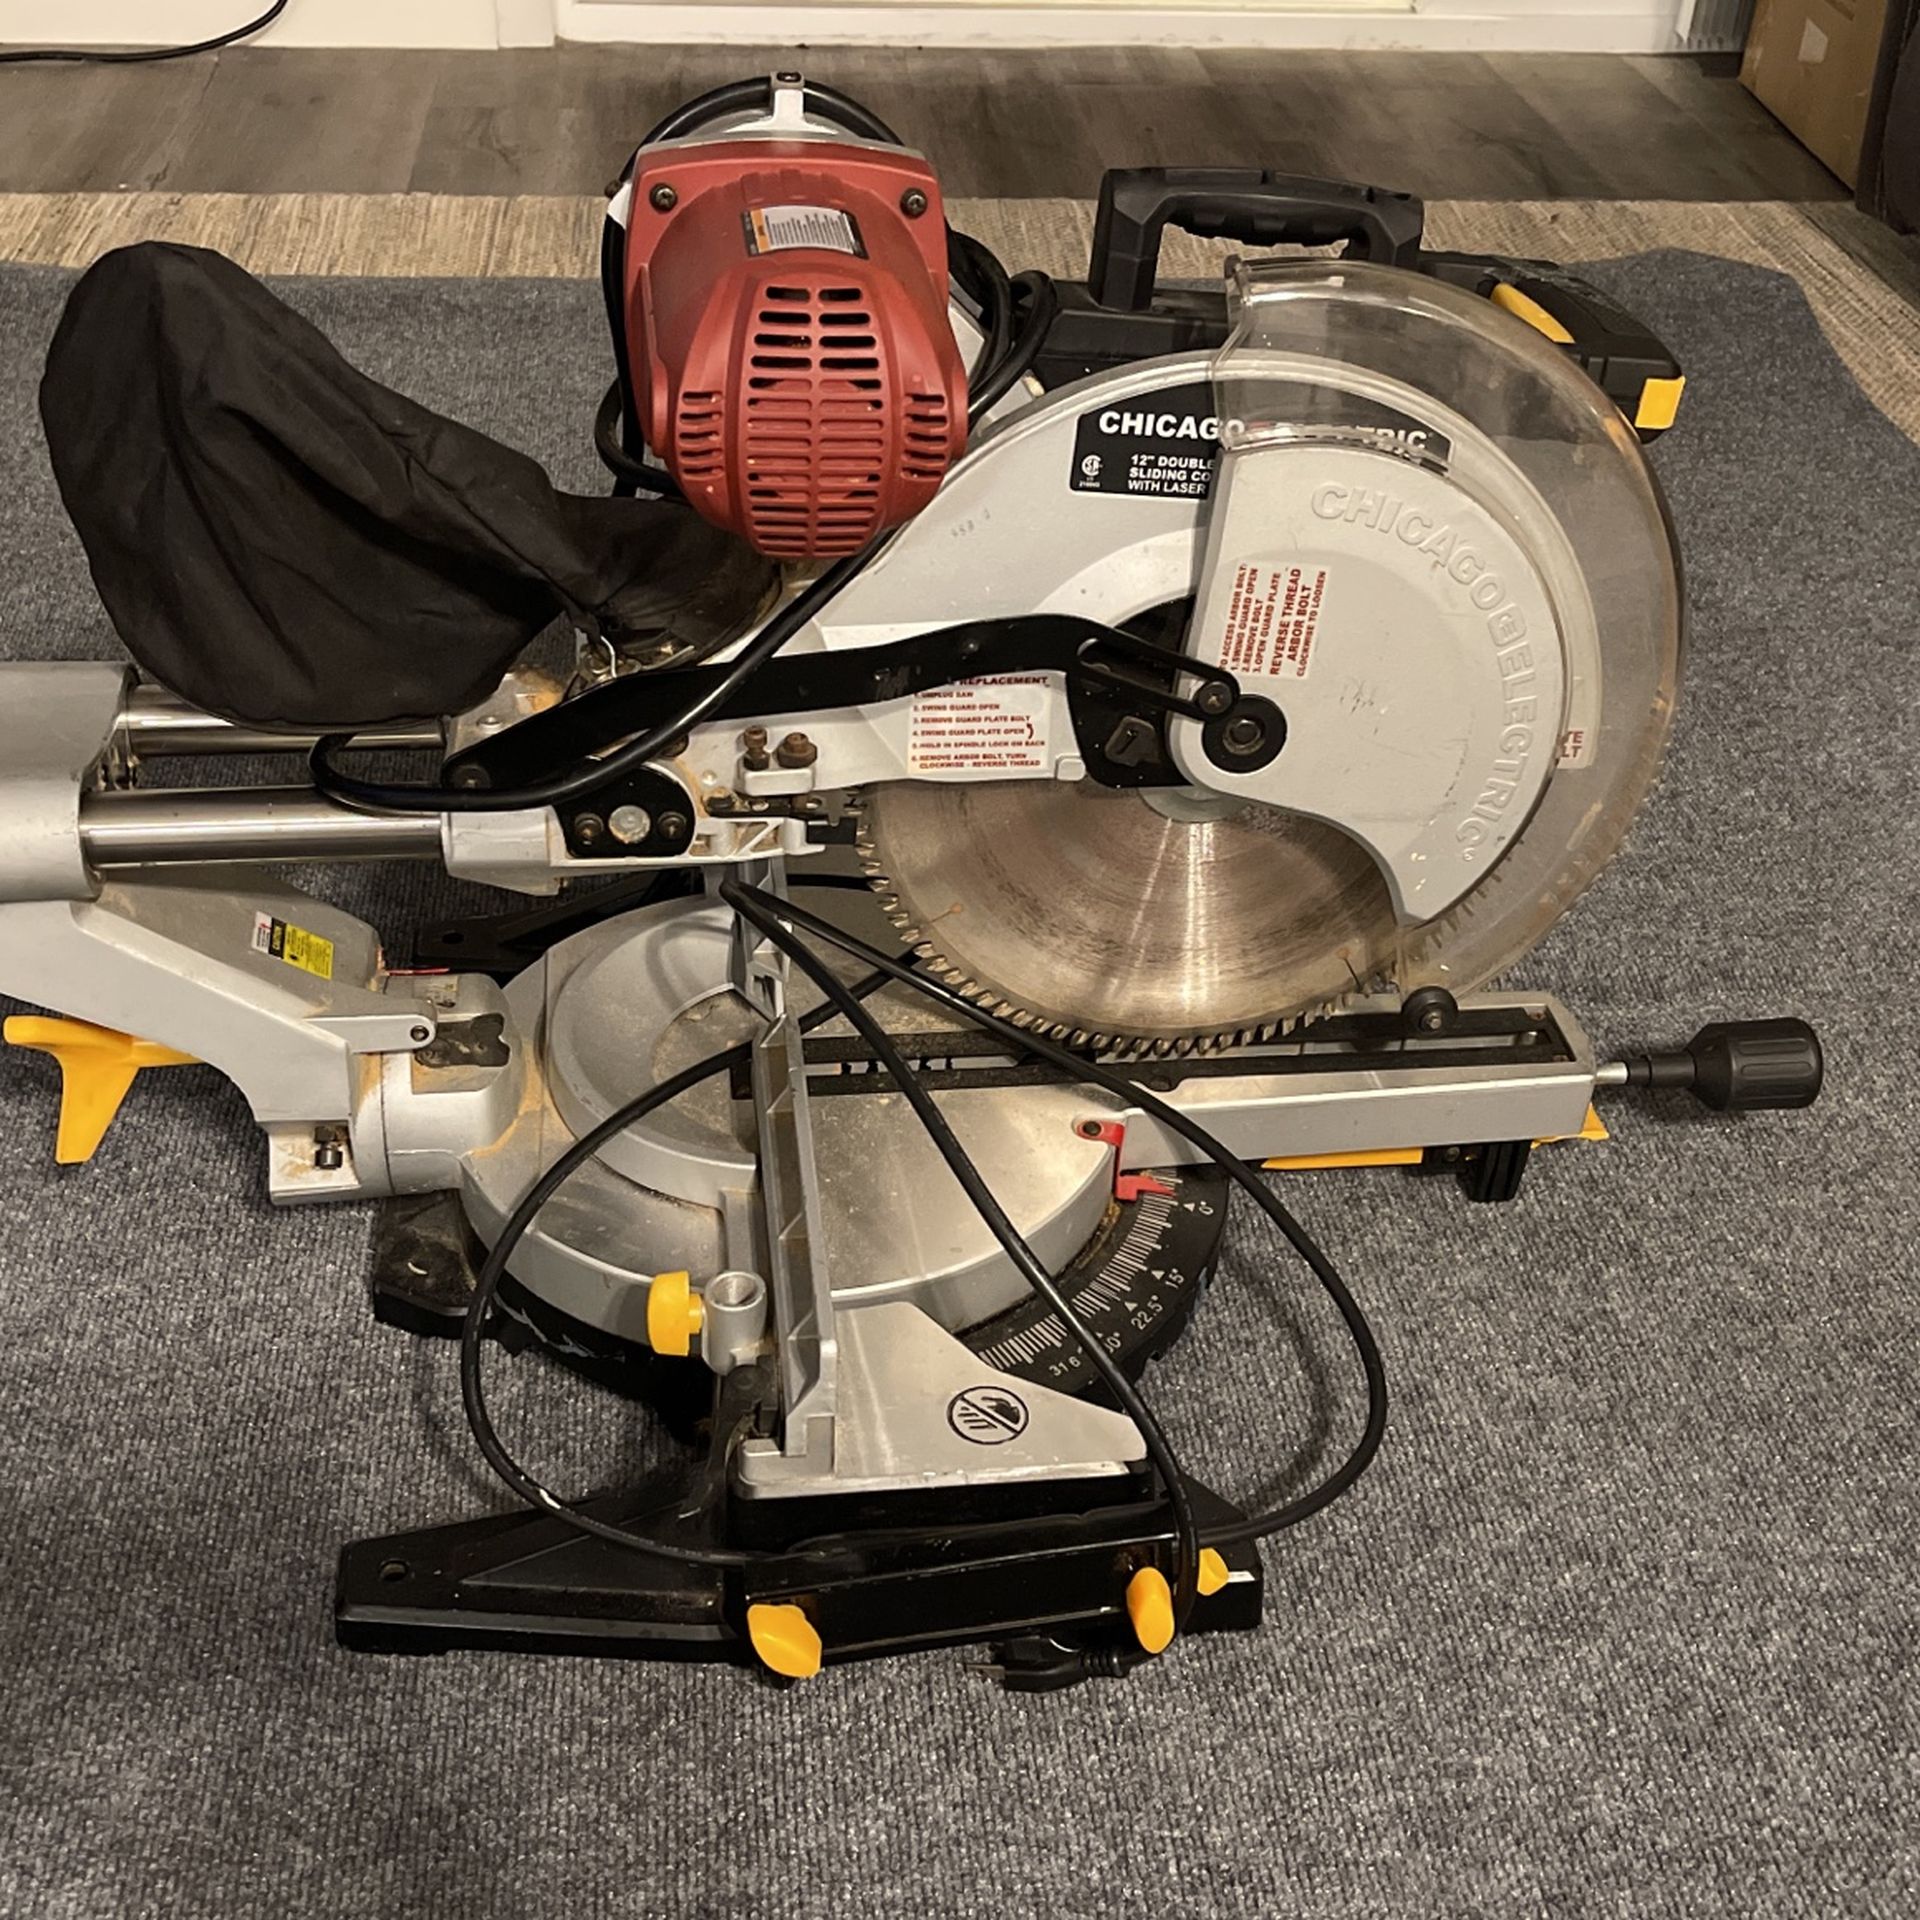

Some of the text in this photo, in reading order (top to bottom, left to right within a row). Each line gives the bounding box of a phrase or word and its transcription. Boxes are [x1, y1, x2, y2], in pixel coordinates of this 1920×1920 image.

[1099, 411, 1246, 441] CHICAGO
[1131, 454, 1215, 470] 12" DOUBLE
[1129, 467, 1187, 481] SLIDING
[1128, 480, 1206, 494] WITH LASER
[1238, 597, 1252, 630] GUARD
[1246, 568, 1258, 594] OPEN
[1260, 604, 1275, 637] GUARD
[1268, 572, 1281, 602] PLATE
[1252, 599, 1264, 623] BOLT
[1222, 623, 1235, 657] ACCESS
[1229, 591, 1242, 621] ARBOR
[1270, 568, 1302, 675] REVERSE THREAD
[1287, 585, 1312, 661] ARBOR BOLT
[1296, 571, 1326, 677] CLOCKWISE TO LOOSEN
[1310, 482, 1505, 612] CHICAGO
[1455, 648, 1538, 848] ELECTRIC
[960, 676, 1048, 686] REPLACEMENT
[956, 690, 974, 698] SAW
[922, 704, 947, 712] SWING
[950, 703, 977, 711] GUARD
[979, 703, 1000, 711] OPEN
[921, 716, 953, 724] REMOVE
[955, 715, 982, 723] GUARD
[984, 715, 1008, 723] PLATE
[948, 728, 976, 736] GUARD
[977, 728, 1001, 736] PLATE
[919, 754, 951, 762] REMOVE
[1005, 752, 1027, 760] TURN
[919, 761, 965, 769] CLOCKWISE
[972, 760, 1008, 768] REVERSE
[1009, 759, 1041, 767] THREAD
[1199, 1201, 1214, 1216] 0°
[1165, 1268, 1185, 1289] 15°
[1131, 1295, 1164, 1331] 22.5°
